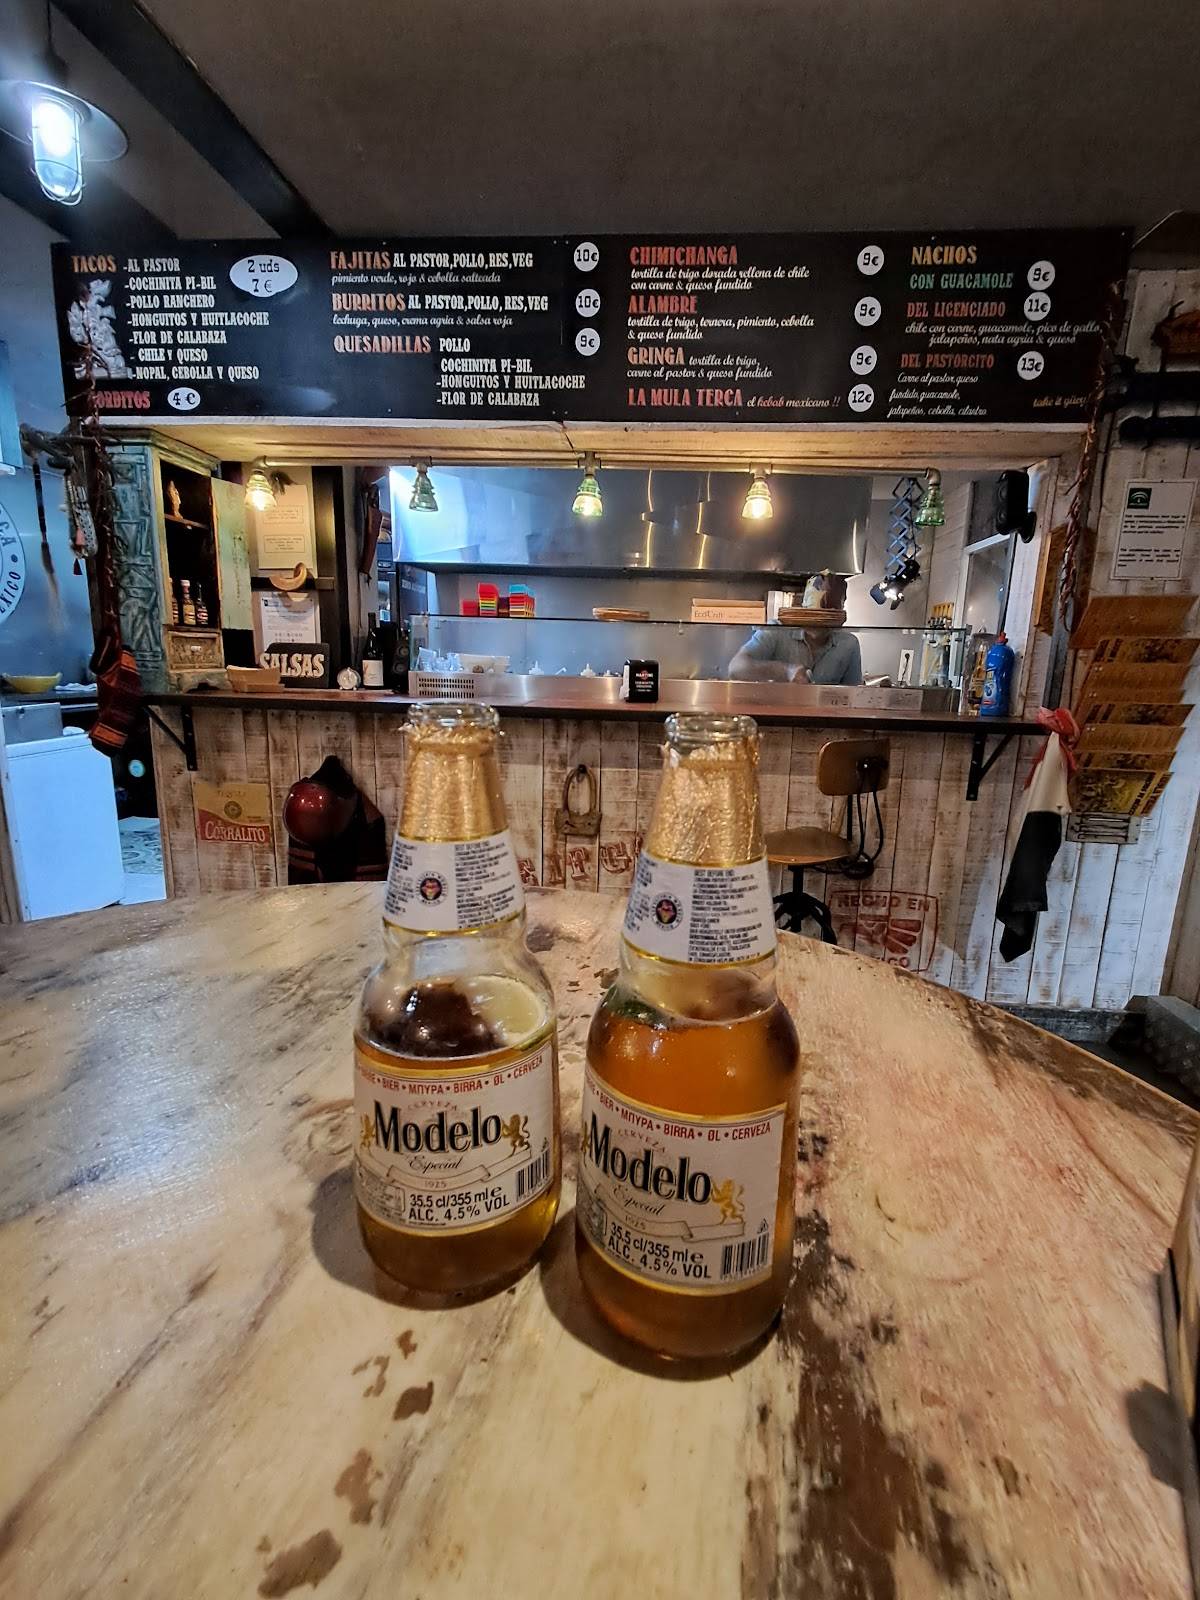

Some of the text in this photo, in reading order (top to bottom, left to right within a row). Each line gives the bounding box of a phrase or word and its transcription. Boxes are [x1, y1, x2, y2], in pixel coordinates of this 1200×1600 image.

[71, 255, 117, 273] TACOS
[330, 250, 407, 270] FAJITAS AL
[629, 245, 738, 266] CHIMICHANGA
[911, 245, 978, 266] NACHOS
[143, 258, 181, 272] PASTOR
[247, 259, 280, 273] 2 uds
[631, 265, 810, 282] tortilla de trigo dorada rellena de chile
[186, 276, 217, 291] PI-BIL
[331, 272, 501, 286] pimiento verde, rojo cebolla salteada
[631, 279, 753, 293] con carne & queso fundido
[909, 272, 1014, 290] CON GUACAMOLE
[163, 295, 215, 309] RANCHERO
[332, 293, 422, 312] BURRITOS AL
[628, 294, 698, 314] ALAMBRE
[907, 301, 1006, 318] DEL LICENCIADO
[191, 313, 199, 326] Y
[202, 312, 270, 326] HUITLACOCHE
[332, 314, 513, 329] lechuga, queso, crema agria salsa roja
[627, 315, 815, 330] tortilla de trigo, ternera, pimiento, cebolla
[161, 331, 174, 344] DE
[177, 331, 227, 344] CALABAZA
[627, 328, 704, 343] & queso fundido
[905, 321, 928, 334] chile
[929, 324, 945, 333] con
[946, 324, 977, 335] carne,
[978, 321, 1035, 337] guacamole,
[1037, 322, 1058, 337] pico
[1059, 321, 1071, 333] de
[333, 335, 471, 354] QUESADILLAS POLLO
[929, 333, 1077, 348] jalapeños, nata agria queso
[138, 348, 208, 365] CHILE QUESO
[627, 347, 761, 369] GRINGA tortilla de trigo,
[900, 353, 995, 369] DEL PASTORCITO
[172, 366, 214, 380] CEBOLLA
[217, 366, 224, 380] Y
[228, 366, 260, 382] QUESO
[440, 358, 533, 373] COCHINITA PI-BIL
[504, 375, 511, 389] Y
[514, 375, 586, 389] HUITLACOCHE
[627, 367, 773, 382] carne al pastor queso fundido
[470, 391, 484, 406] DE
[487, 391, 540, 406] CALABAZA
[628, 388, 830, 408] LA MULA TERCA el kebab mexicano
[259, 652, 325, 678] SALSAS
[453, 1080, 483, 1094] BIRRA
[513, 1055, 543, 1079] CERVEZA
[374, 1100, 503, 1154] Modelo
[663, 1123, 695, 1140] BIRRA
[731, 1122, 772, 1141] CERVEZA
[589, 1111, 713, 1206] Modelo
[409, 1187, 489, 1208] 35.5 cl/355 ml
[409, 1194, 510, 1222] ALC. 4.5% VOL
[610, 1221, 689, 1263] 35.5 cl/355 ml
[608, 1235, 635, 1262] ALC.
[639, 1254, 678, 1276] 4.5%
[682, 1263, 712, 1279] VOL
